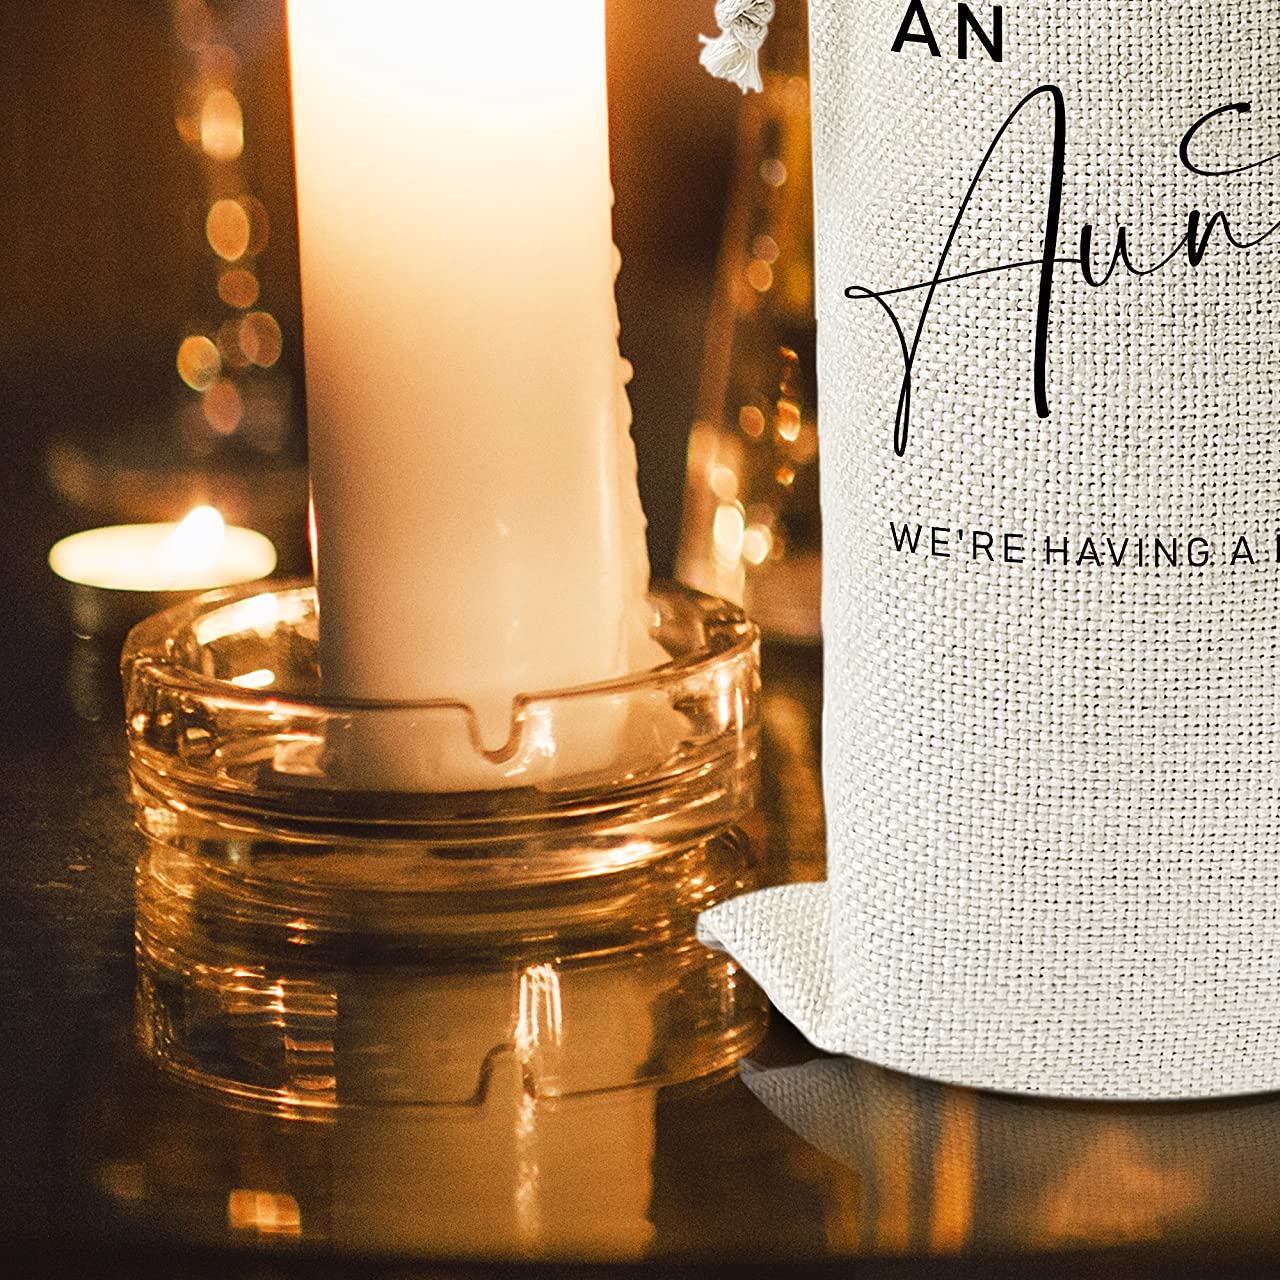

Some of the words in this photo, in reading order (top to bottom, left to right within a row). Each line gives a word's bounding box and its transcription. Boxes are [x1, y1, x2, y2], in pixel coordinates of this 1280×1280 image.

[889, 520, 1025, 565] WE'RE
[1045, 535, 1210, 568] HAVING
[1230, 535, 1255, 566] A
